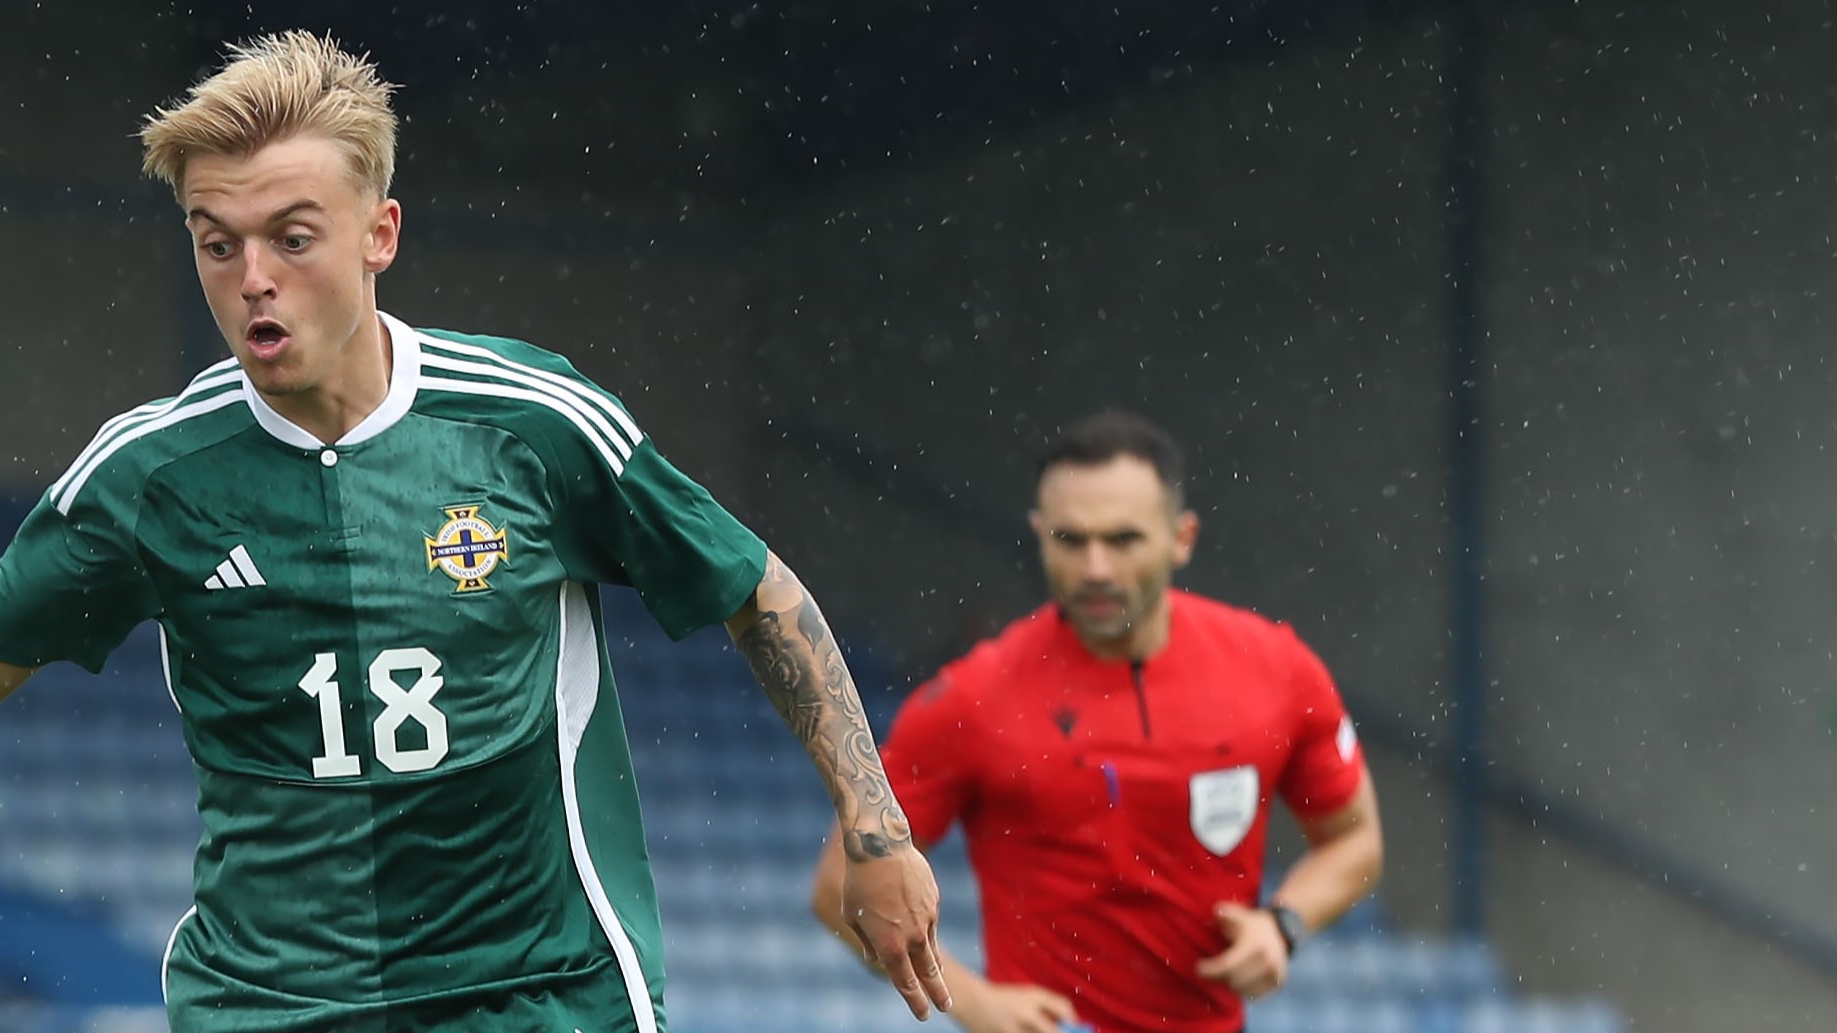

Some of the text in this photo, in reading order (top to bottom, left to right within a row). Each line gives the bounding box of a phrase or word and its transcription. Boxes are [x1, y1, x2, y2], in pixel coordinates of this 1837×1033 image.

[456, 521, 490, 538] FOOTBALL
[437, 545, 470, 555] NORTHERN
[448, 559, 492, 577] ASSOCIATION
[298, 647, 449, 778] 18
